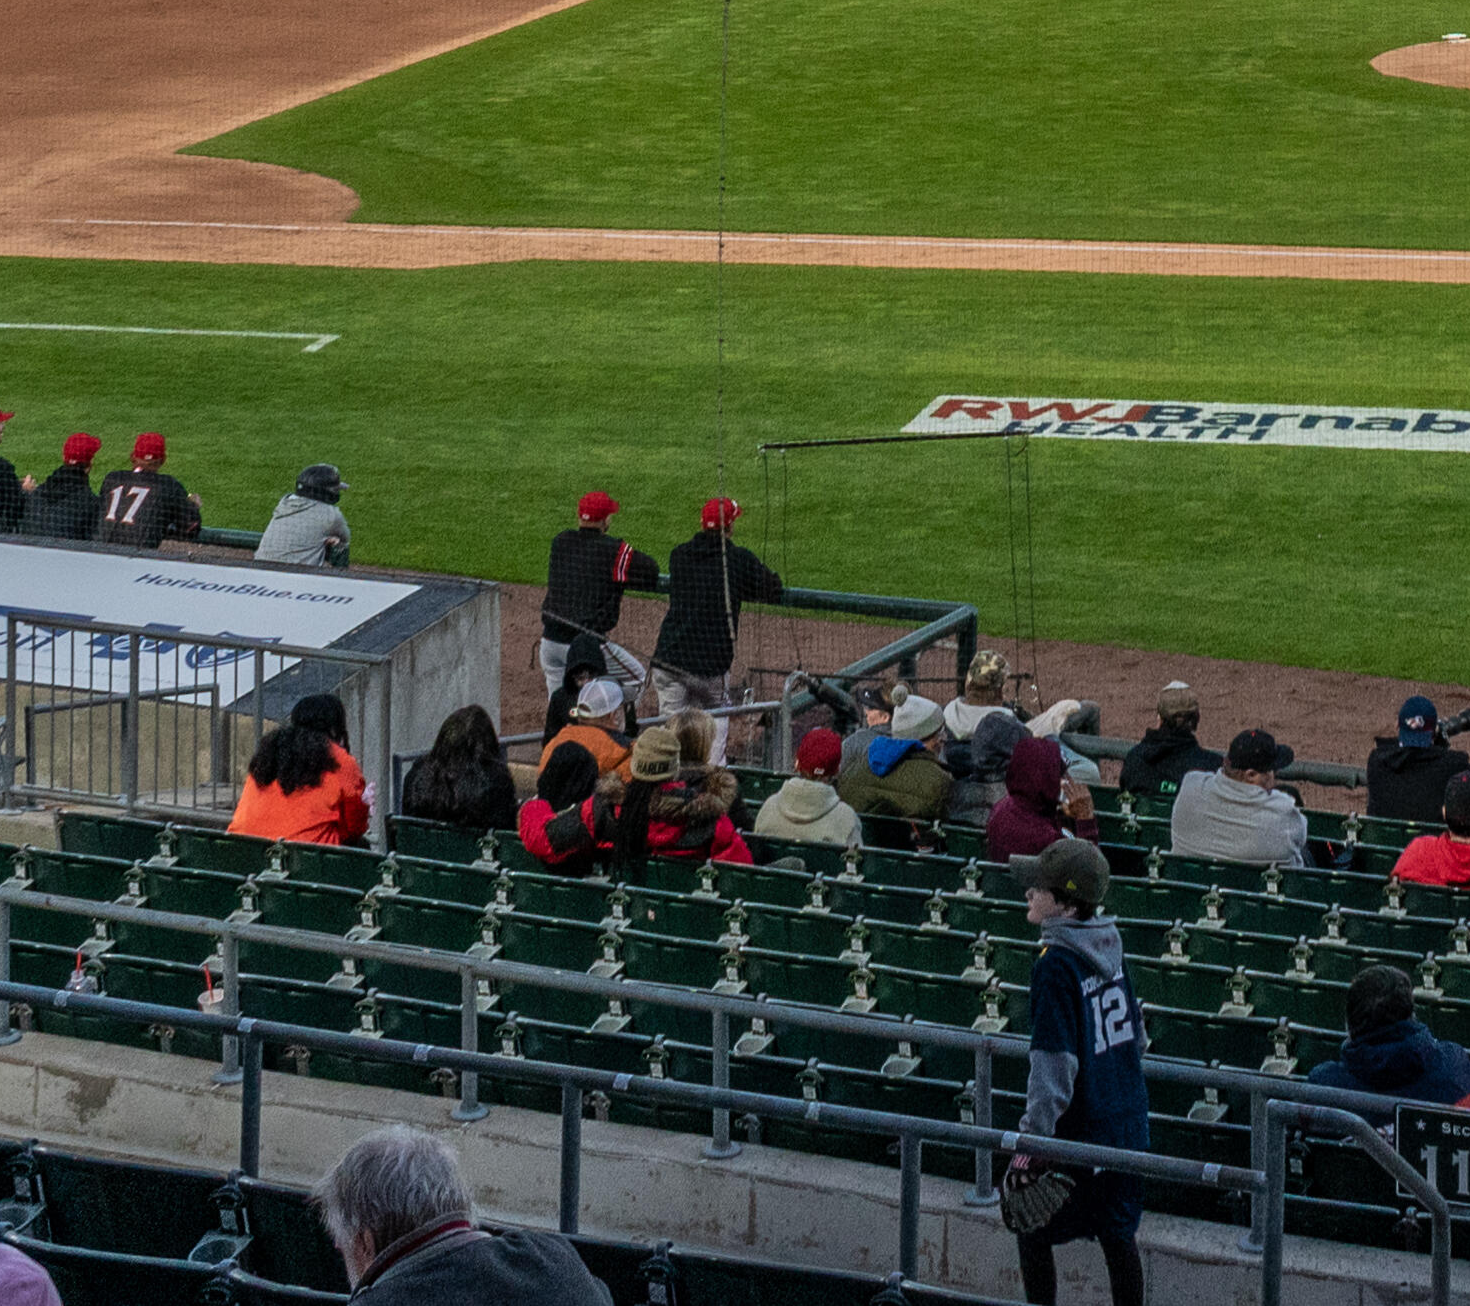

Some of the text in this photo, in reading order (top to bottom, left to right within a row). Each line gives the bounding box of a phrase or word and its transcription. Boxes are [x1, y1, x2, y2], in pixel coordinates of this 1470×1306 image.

[103, 485, 152, 523] 17
[133, 572, 354, 606] HorizonBlue.com
[1091, 986, 1134, 1055] 12
